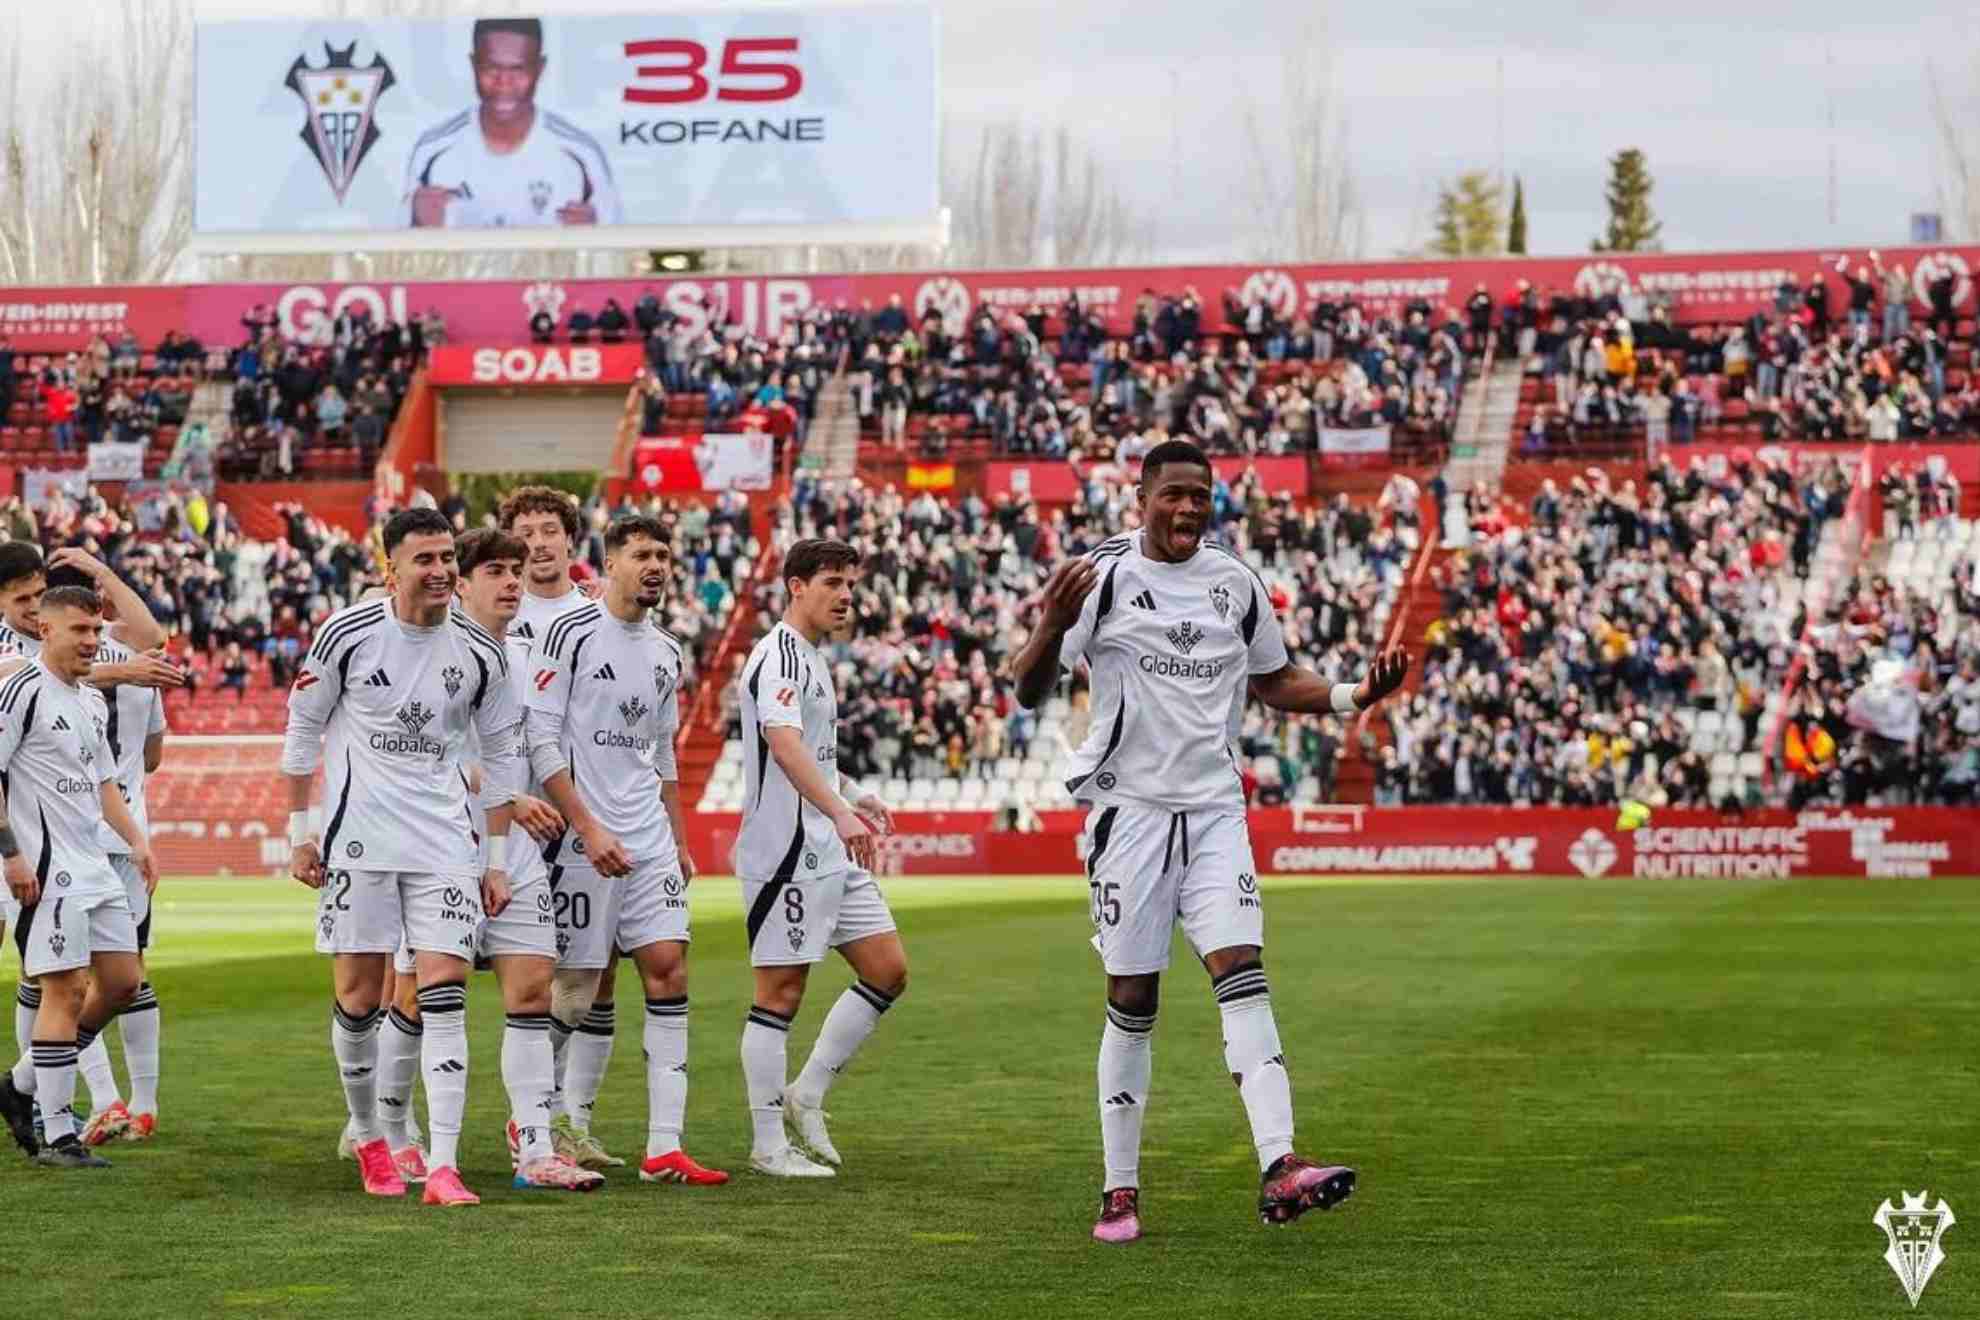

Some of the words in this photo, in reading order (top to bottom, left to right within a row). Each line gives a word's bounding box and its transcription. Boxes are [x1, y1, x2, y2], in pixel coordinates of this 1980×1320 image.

[623, 38, 804, 104] 35
[620, 116, 825, 145] KOFANE
[472, 348, 602, 382] SOAB
[1633, 853, 1793, 879] NUTRITION
[552, 891, 591, 930] 20
[783, 887, 805, 924] 8
